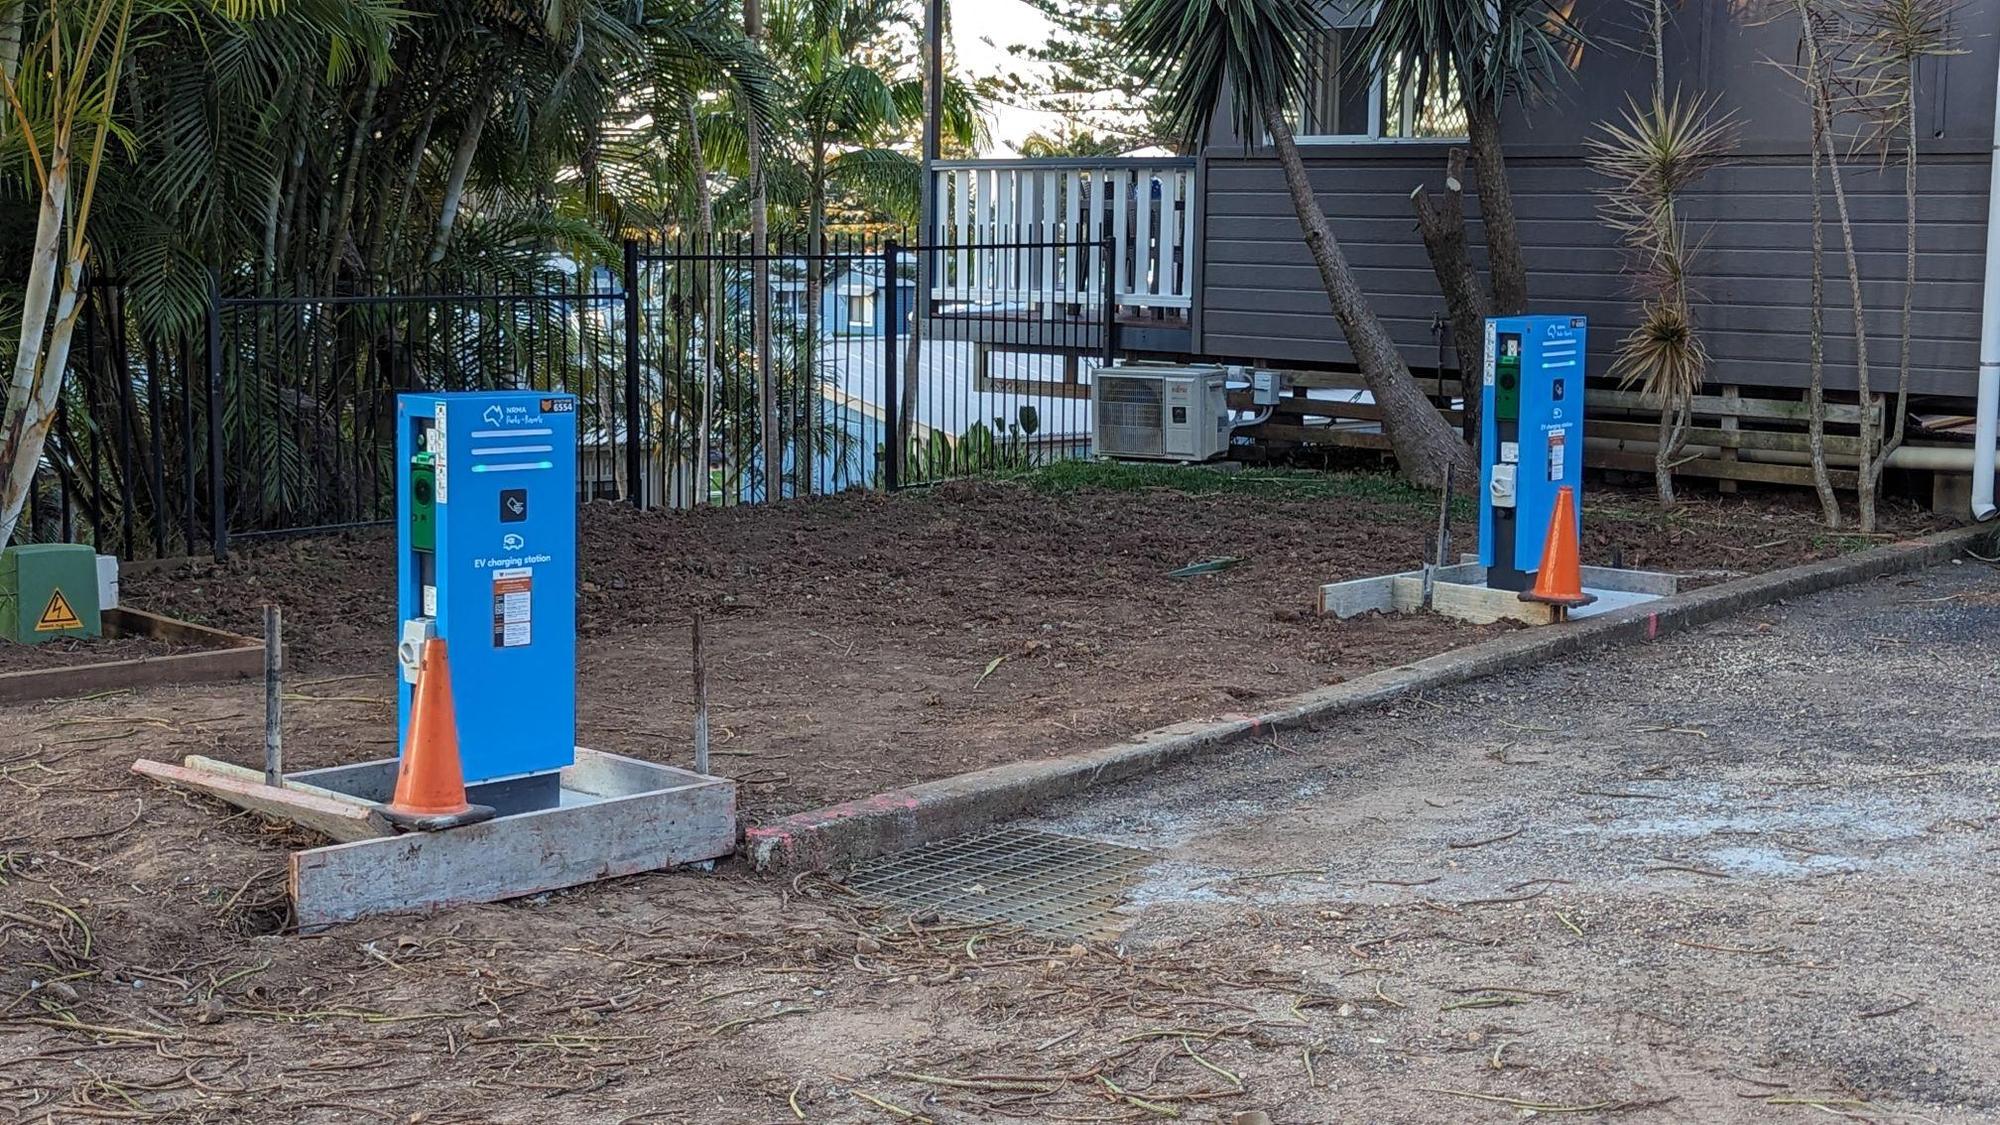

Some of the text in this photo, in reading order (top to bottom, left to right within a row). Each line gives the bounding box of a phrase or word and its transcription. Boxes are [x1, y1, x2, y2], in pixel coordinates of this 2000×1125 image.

[506, 406, 527, 414] NRMA
[553, 403, 573, 412] 6554
[474, 554, 551, 568] EV charging station
